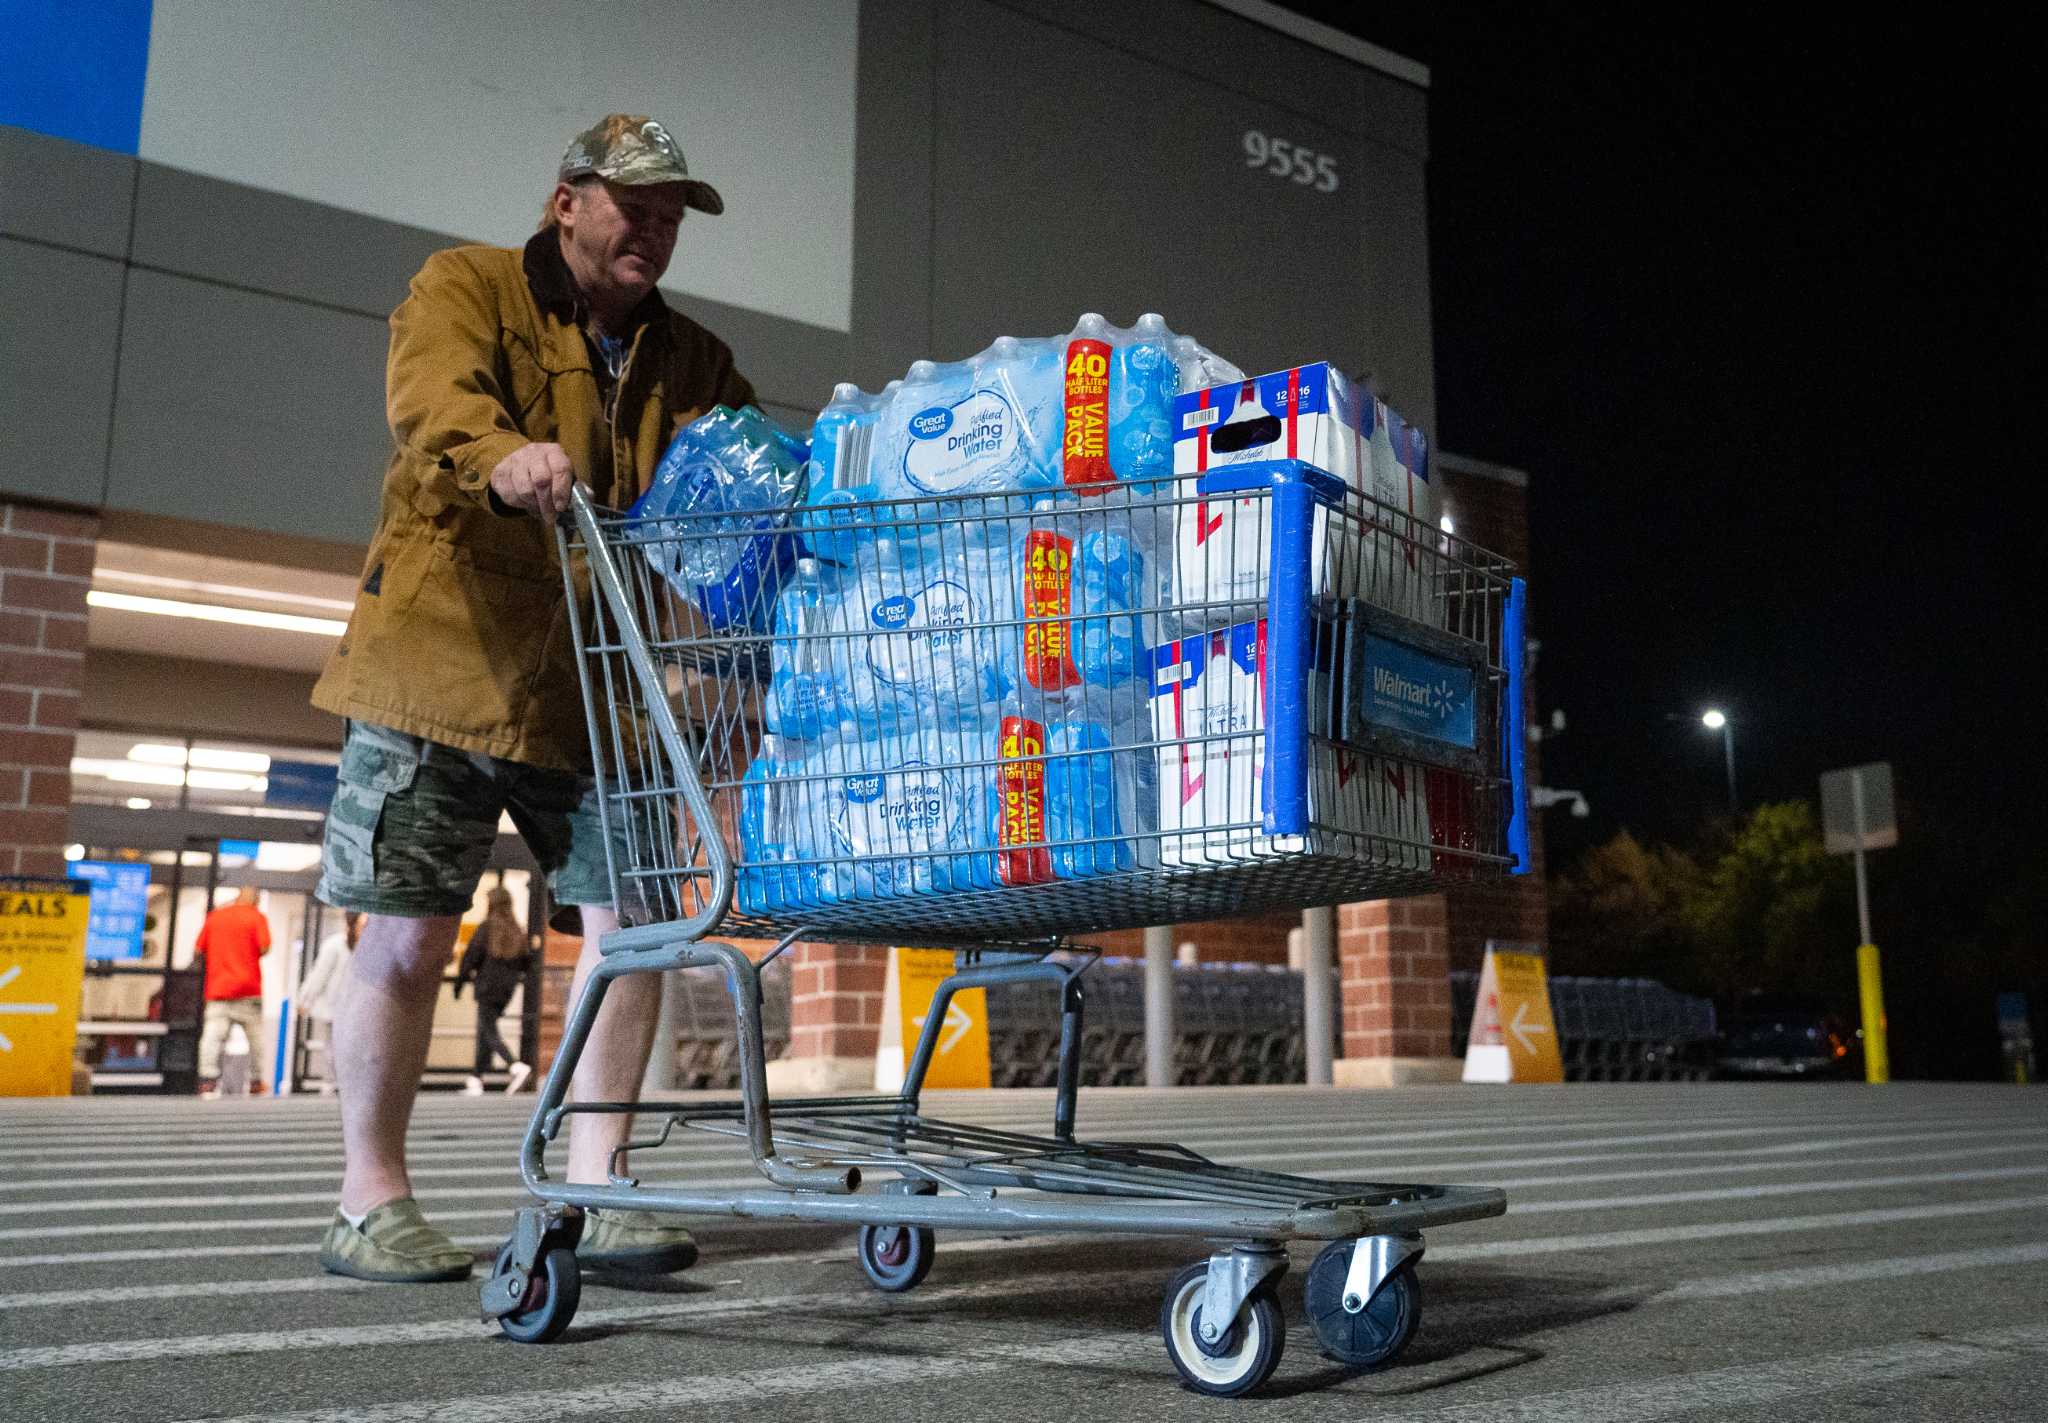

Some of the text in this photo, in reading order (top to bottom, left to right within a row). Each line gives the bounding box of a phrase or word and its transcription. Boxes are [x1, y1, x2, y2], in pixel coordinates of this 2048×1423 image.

[1243, 130, 1339, 192] 9555
[1067, 353, 1107, 378] 40
[1066, 378, 1108, 389] HALF LITER
[1069, 385, 1103, 395] BOTTLES
[1276, 385, 1310, 400] 12 16
[913, 412, 946, 429] Great
[921, 423, 946, 433] Value
[1085, 401, 1105, 458] VALUE
[948, 424, 1003, 451] Drinking
[1066, 405, 1084, 461] PACK
[963, 439, 1002, 458] Water
[1028, 545, 1068, 571] 40
[1030, 581, 1065, 590] OTTLS
[1048, 572, 1069, 581] LIER
[876, 603, 909, 616] Grea
[1374, 666, 1431, 707] Walmart
[1199, 713, 1247, 736] LTRA
[1003, 735, 1040, 759] 40
[854, 787, 878, 797] Vaue
